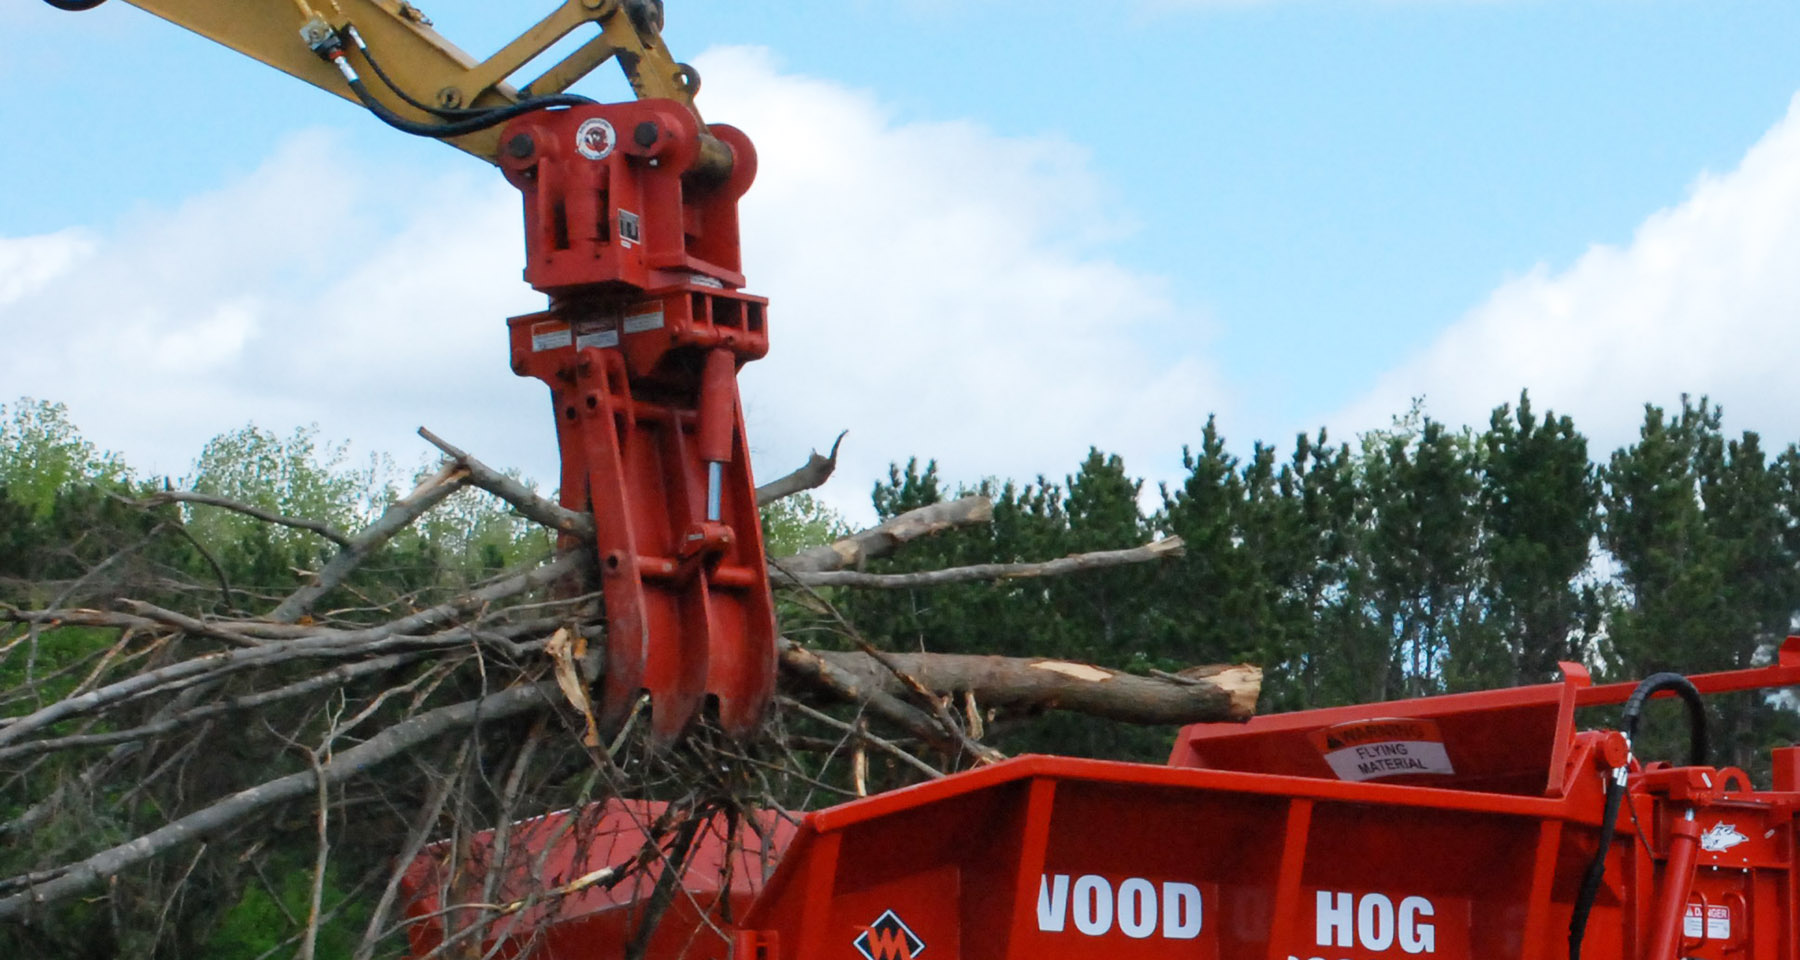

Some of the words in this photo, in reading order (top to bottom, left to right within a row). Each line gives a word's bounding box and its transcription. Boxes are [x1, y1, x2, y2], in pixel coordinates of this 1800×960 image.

[1356, 744, 1408, 759] FLYING
[1358, 758, 1428, 774] MATERIAL
[1315, 890, 1436, 954] HOG
